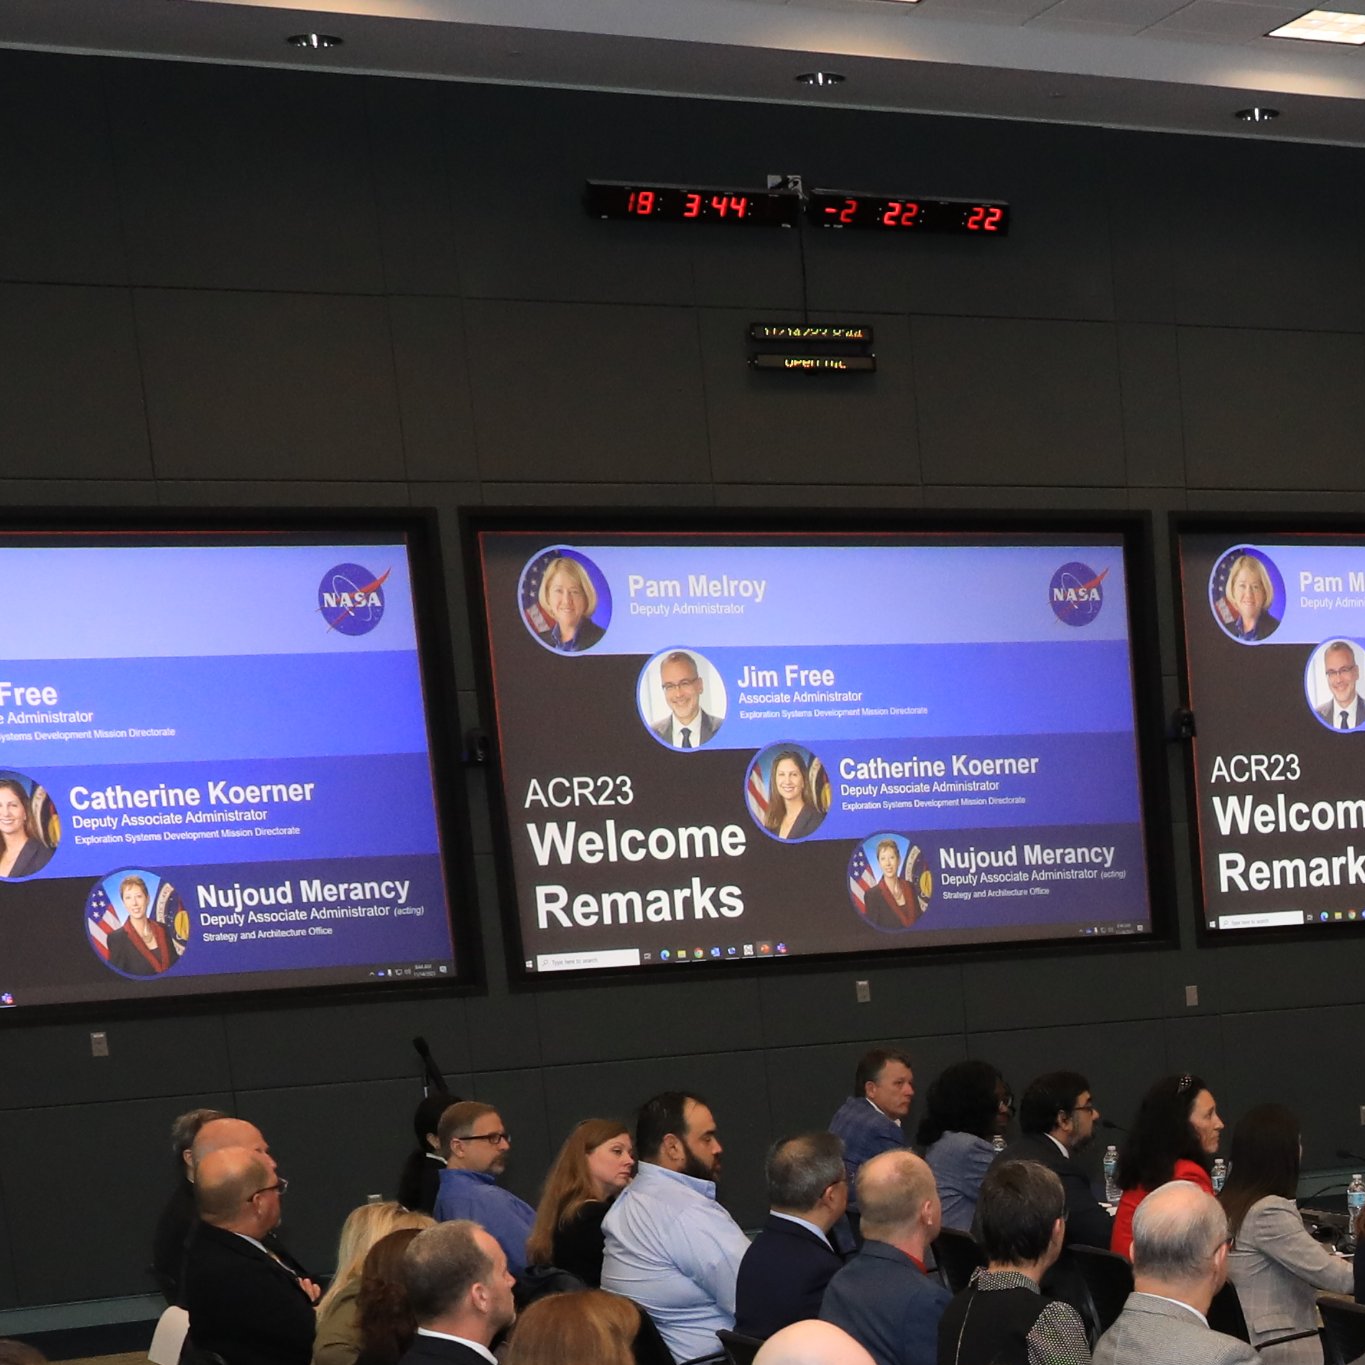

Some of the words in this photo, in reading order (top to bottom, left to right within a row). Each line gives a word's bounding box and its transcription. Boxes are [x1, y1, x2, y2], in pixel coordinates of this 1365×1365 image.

[628, 191, 655, 214] 18
[629, 575, 681, 597] Pam
[688, 575, 766, 603] Melroy
[1300, 571, 1342, 592] Pam
[323, 592, 381, 607] NASA
[1053, 588, 1100, 601] NASA
[1301, 597, 1333, 609] Deputy
[630, 603, 669, 617] Deputy
[673, 603, 744, 614] Administrator
[738, 666, 778, 687] Jim
[785, 665, 834, 687] Free
[0, 682, 58, 706] Free
[739, 692, 790, 704] Associate
[793, 691, 862, 703] Administrator
[8, 711, 93, 724] Administrator
[740, 710, 780, 719] Exploration
[782, 709, 812, 719] Systems
[814, 708, 860, 717] Development
[0, 733, 32, 743] ystems
[34, 731, 91, 741] Development
[94, 729, 126, 738] Mission
[128, 728, 175, 737] Directorate
[840, 757, 945, 779] Catherine
[952, 754, 1039, 776] Koerner
[1211, 754, 1300, 783] ACR23
[69, 784, 200, 810] Catherine
[208, 781, 314, 805] Koerner
[525, 776, 633, 808] ACR23
[841, 784, 877, 797] Deputy
[880, 782, 930, 794] Associate
[932, 780, 1000, 792] Administrator
[842, 802, 881, 811] Exploration
[882, 801, 912, 809] Systems
[914, 799, 959, 808] Development
[988, 796, 1026, 804] Directorate
[73, 815, 117, 830] Deputy
[121, 811, 182, 826] Associate
[186, 809, 268, 823] Administrator
[75, 834, 123, 845] Exploration
[125, 833, 162, 843] Systems
[163, 830, 219, 841] Development
[221, 829, 253, 837] Mission
[254, 827, 300, 836] Directorate
[527, 819, 746, 865] Welcome
[939, 846, 1017, 873] Nujoud
[1024, 844, 1114, 867] Merancy
[942, 873, 977, 886] Deputy
[980, 871, 1029, 883] Associate
[1031, 868, 1097, 881] Administrator
[197, 881, 292, 912] Nujoud
[300, 880, 410, 904] Merancy
[536, 877, 744, 928] Remarks
[943, 891, 971, 900] Strategy
[973, 890, 986, 898] and
[988, 889, 1028, 897] Architecture
[200, 912, 245, 927] Deputy
[248, 909, 307, 923] Associate
[310, 905, 390, 919] Administrator
[203, 931, 238, 942] Strategy
[240, 931, 256, 939] and
[257, 927, 307, 938] Architecture
[308, 926, 333, 935] Office
